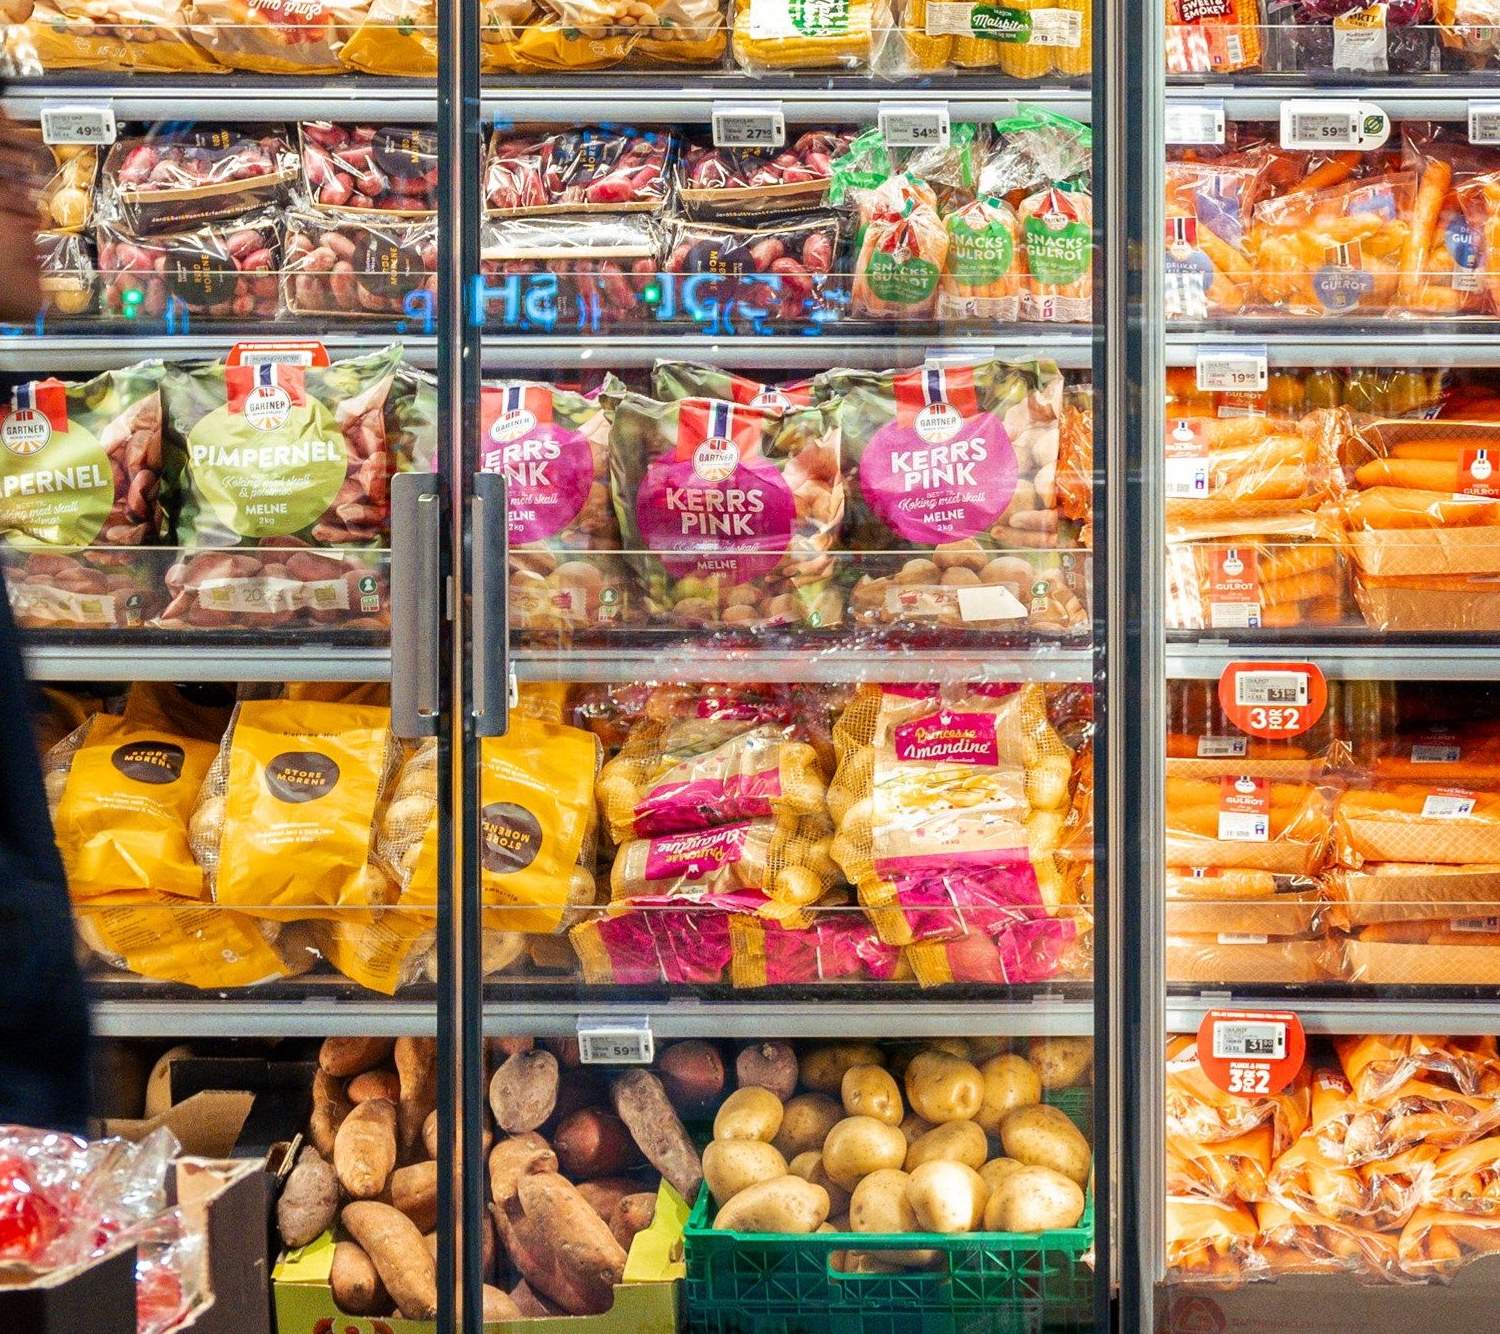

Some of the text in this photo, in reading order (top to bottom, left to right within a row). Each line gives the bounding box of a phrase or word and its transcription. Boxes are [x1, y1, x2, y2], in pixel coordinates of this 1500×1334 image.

[1182, 8, 1228, 26] SMOKEY
[1027, 246, 1083, 261] GULROT
[248, 400, 288, 413] GARTNER
[919, 415, 959, 428] GARTNER
[6, 424, 46, 437] GARTNER
[193, 441, 342, 467] PIMPERNEL
[891, 439, 988, 474] KERRS
[903, 465, 977, 492] PINK
[1463, 488, 1500, 496] GULROT
[666, 487, 765, 514] KERRS
[245, 503, 288, 516] MELNE
[923, 509, 965, 524] MELNE
[681, 512, 755, 536] PINK
[936, 521, 953, 532] 2kg
[697, 559, 737, 571] MELNE
[1215, 582, 1254, 591] GULROT
[904, 740, 991, 758] Amandine
[277, 773, 326, 787] MORENE
[283, 767, 323, 780] STORE
[1226, 797, 1264, 806] GULROT
[1227, 1069, 1270, 1093] 3 2
